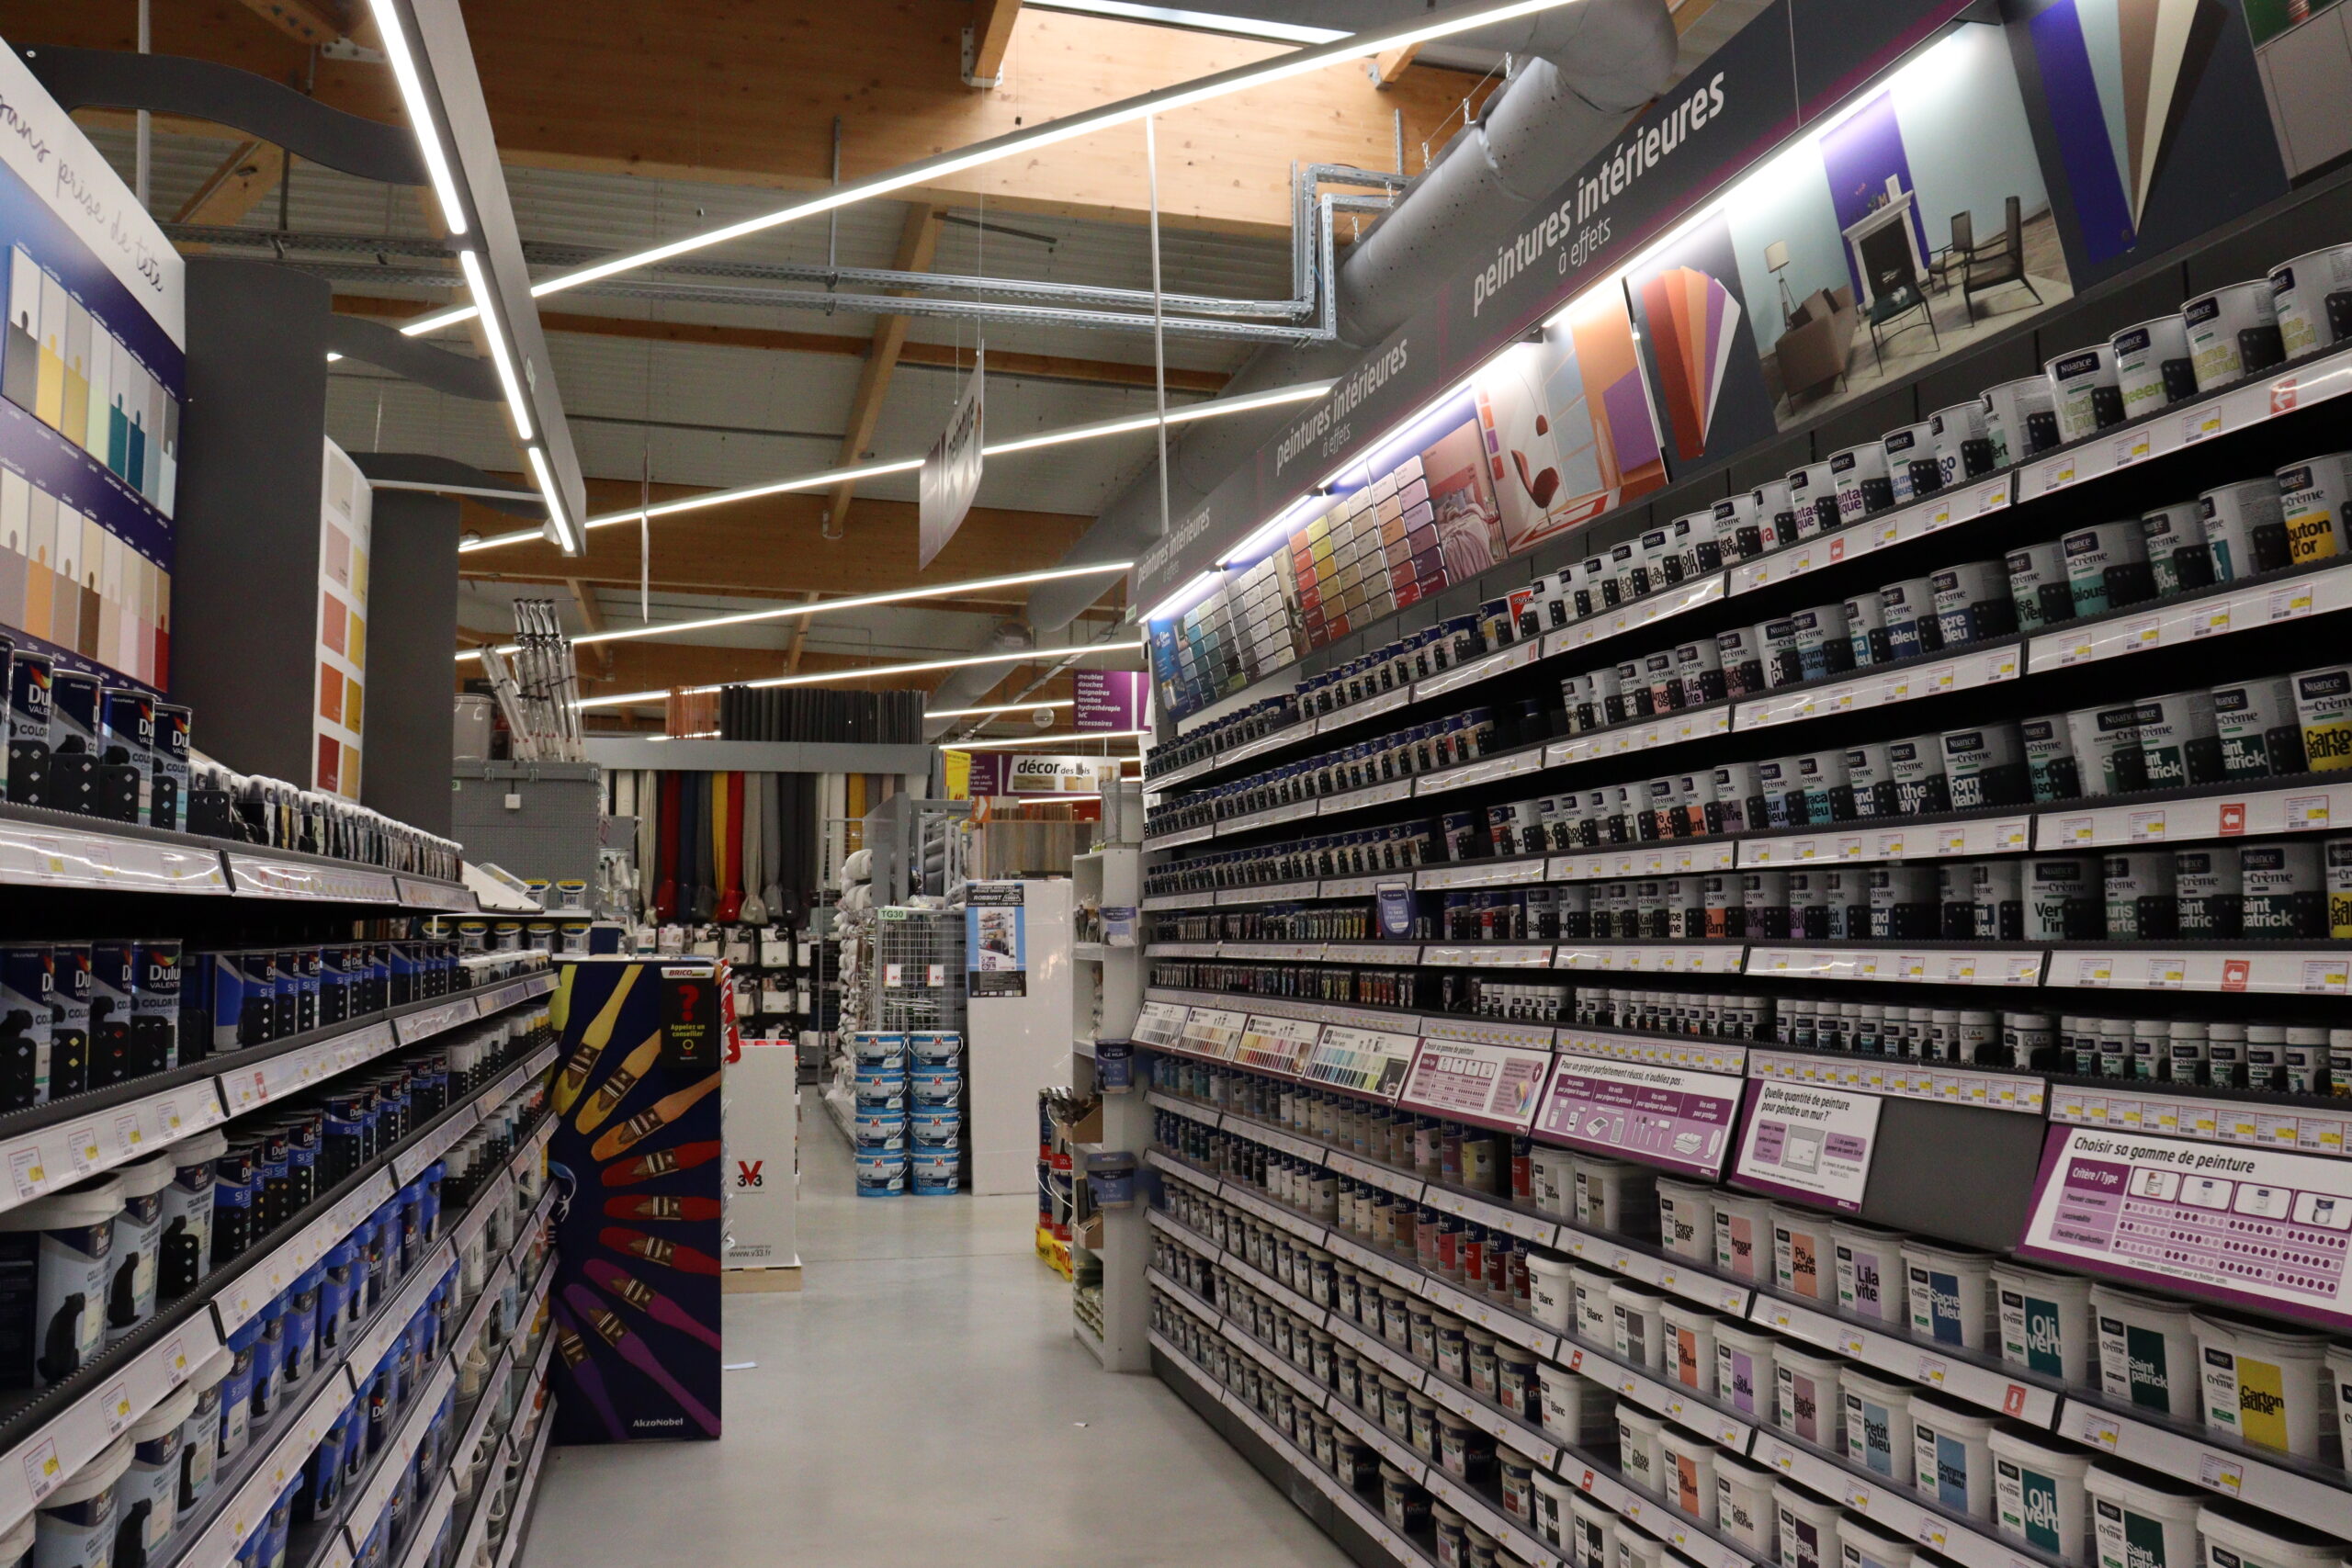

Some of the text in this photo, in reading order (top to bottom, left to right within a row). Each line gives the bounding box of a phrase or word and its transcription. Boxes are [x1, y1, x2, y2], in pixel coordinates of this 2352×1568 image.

[1475, 71, 1724, 317] peintures intérieures
[56, 158, 104, 224] prise
[111, 210, 130, 254] de
[136, 236, 163, 292] tête
[1559, 218, 1611, 275] à effets
[2060, 356, 2093, 375] Nuance
[1275, 338, 1408, 477] peintures intérieures
[946, 396, 975, 482] peinture
[1322, 423, 1351, 457] à effets
[2287, 490, 2324, 506] Crème
[1137, 507, 1210, 589] peintures intérieures
[2292, 538, 2317, 558] d'or
[2074, 550, 2108, 566] Crème
[2303, 677, 2341, 694] Nuance
[1950, 737, 1976, 747] Nuance
[1957, 750, 1992, 761] Crème
[1017, 759, 1060, 774] décor
[1897, 760, 1923, 773] Crème
[1902, 782, 1927, 800] the
[2041, 865, 2074, 876] Nuance
[2250, 872, 2292, 884] Crème
[2049, 881, 2086, 892] Crème
[881, 910, 904, 919] TG30
[1425, 1042, 1436, 1050] Choisir
[1458, 1047, 1475, 1055] peinture
[1561, 1060, 1572, 1070] Pour
[1578, 1064, 1594, 1075] projet
[1593, 1066, 1627, 1078] parfaitement
[1627, 1069, 1645, 1081] réussi,
[1645, 1073, 1670, 1085] n'oubliez
[1670, 1077, 1680, 1086] pas
[1764, 1088, 1850, 1111] Quelle quantité de peinture
[1761, 1102, 1823, 1121] pour peindre un mur
[2074, 1136, 2255, 1174] Choisir sa gamme de peinture
[2072, 1168, 2119, 1184] Critère Type
[2066, 1194, 2107, 1206] Pouvoir couvrant
[1675, 1220, 1694, 1235] Porce
[1675, 1229, 1691, 1242] laine
[1731, 1237, 1752, 1250] Amour
[1736, 1246, 1748, 1257] ose
[729, 1248, 772, 1258] www.v33.fr
[1794, 1247, 1815, 1266] Pô de
[1792, 1259, 1815, 1275] pêche
[1858, 1264, 1880, 1286] Lila
[1539, 1292, 1554, 1307] Blanc
[1855, 1281, 1877, 1303] vite
[1929, 1289, 1960, 1306] Sacre
[1587, 1307, 1603, 1323] Blanc
[1938, 1303, 1961, 1321] bleu
[2031, 1314, 2055, 1337] Oli
[1678, 1344, 1689, 1358] Fla
[2026, 1332, 2063, 1356] vert
[2102, 1341, 2125, 1356] Crème
[1680, 1354, 1697, 1370] mant
[2129, 1357, 2155, 1375] Saint
[2208, 1351, 2232, 1367] Nuance
[1736, 1374, 1747, 1387] Gui
[2132, 1369, 2168, 1389] patrick
[2207, 1372, 2234, 1390] Crème
[1734, 1381, 1753, 1397] mauve
[2240, 1385, 2284, 1408] Carton
[1551, 1400, 1566, 1417] Blanc
[1793, 1393, 1815, 1414] Barba
[1794, 1404, 1812, 1420] papa
[2239, 1395, 2275, 1416] jaune
[632, 1417, 684, 1427] AkzoNobel
[1864, 1418, 1888, 1441] Petit
[1868, 1434, 1891, 1454] bleu
[1634, 1449, 1649, 1463] Chou
[1938, 1460, 1966, 1479] Comme
[1938, 1471, 1965, 1490] un bleu
[2029, 1487, 2053, 1511] Oli
[2024, 1506, 2059, 1530] vert
[2098, 1524, 2122, 1542] Crème
[1589, 1540, 1604, 1562] Noir
[1796, 1534, 1814, 1552] Deep
[2126, 1542, 2154, 1562] Saint
[1797, 1544, 1819, 1565] purple
[2215, 1550, 2239, 1567] Nuance
